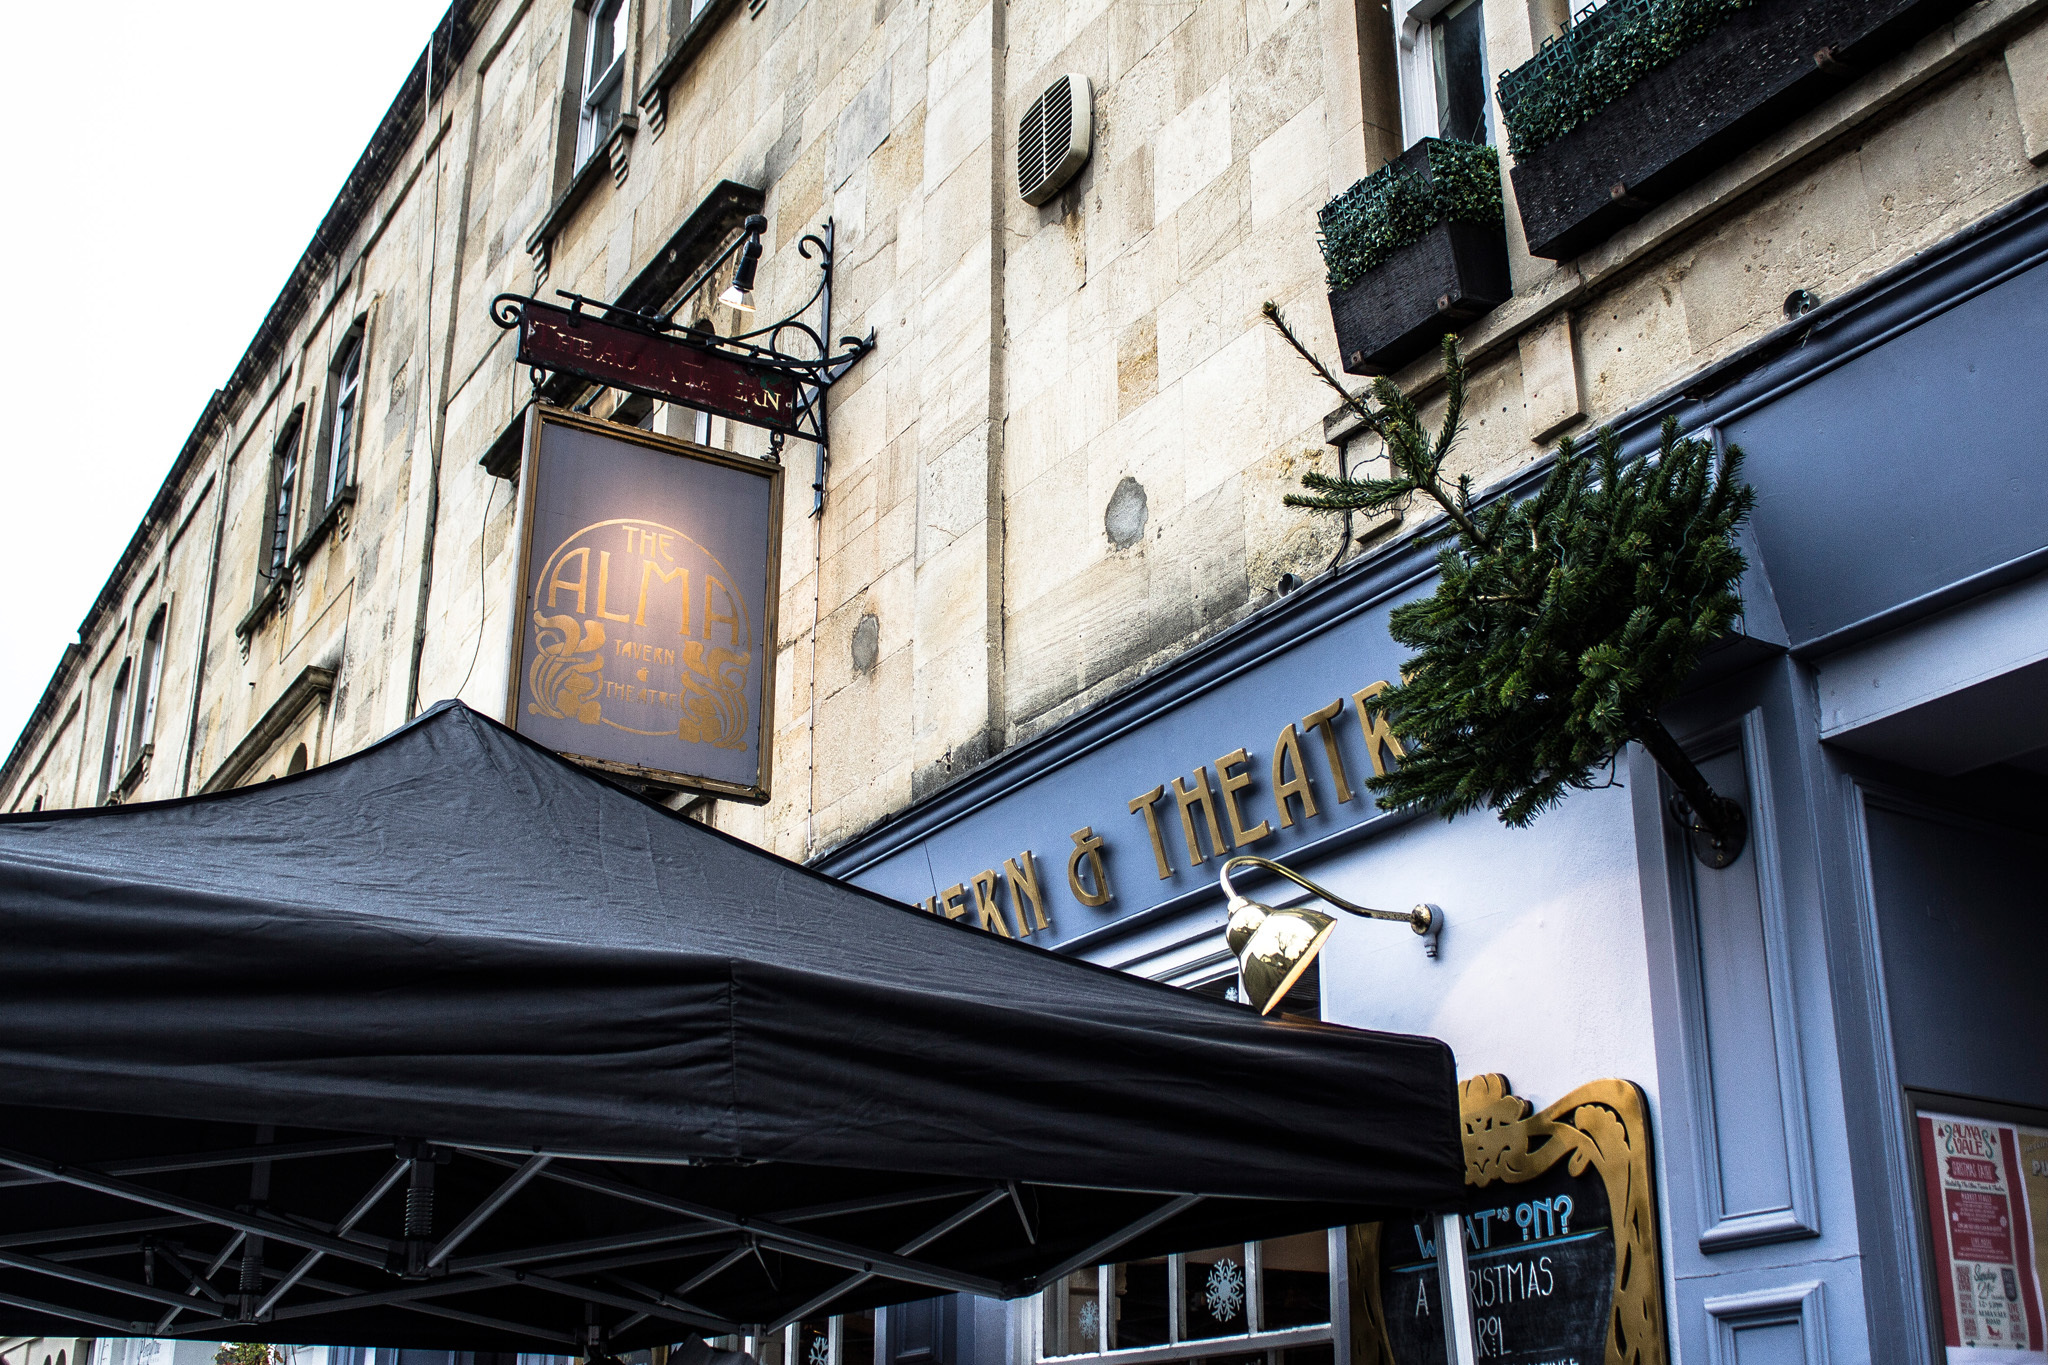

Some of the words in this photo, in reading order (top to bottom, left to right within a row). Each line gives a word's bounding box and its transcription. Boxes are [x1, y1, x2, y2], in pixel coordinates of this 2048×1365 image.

[622, 525, 675, 562] THE
[547, 547, 741, 646] ALMA
[614, 639, 675, 666] TAVERN
[603, 680, 680, 711] THEATRE
[1128, 679, 1407, 880] THEATR
[1515, 1194, 1574, 1242] ON?
[1415, 1278, 1430, 1317] A
